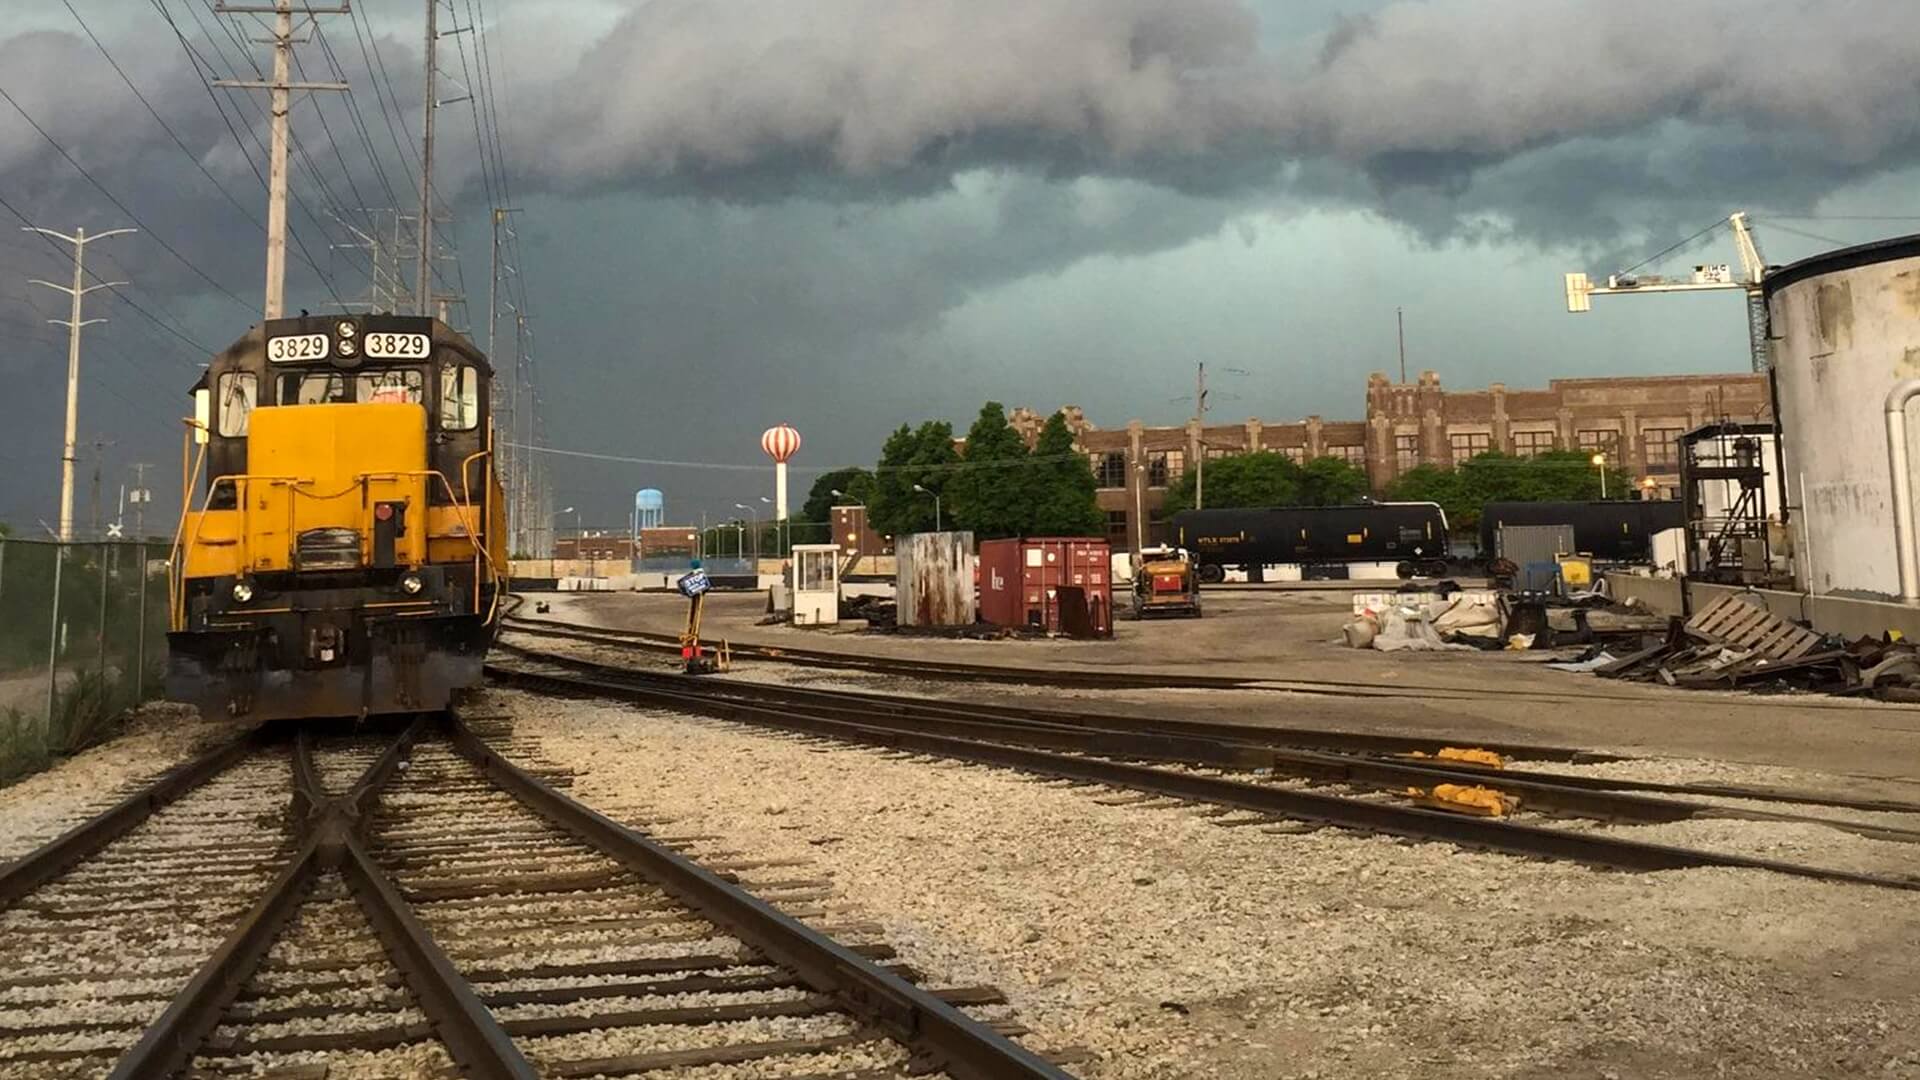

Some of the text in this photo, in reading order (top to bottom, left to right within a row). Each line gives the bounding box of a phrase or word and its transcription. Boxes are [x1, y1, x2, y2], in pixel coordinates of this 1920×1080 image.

[274, 336, 324, 359] 3829
[371, 335, 423, 355] 3829
[684, 572, 704, 587] STOP
